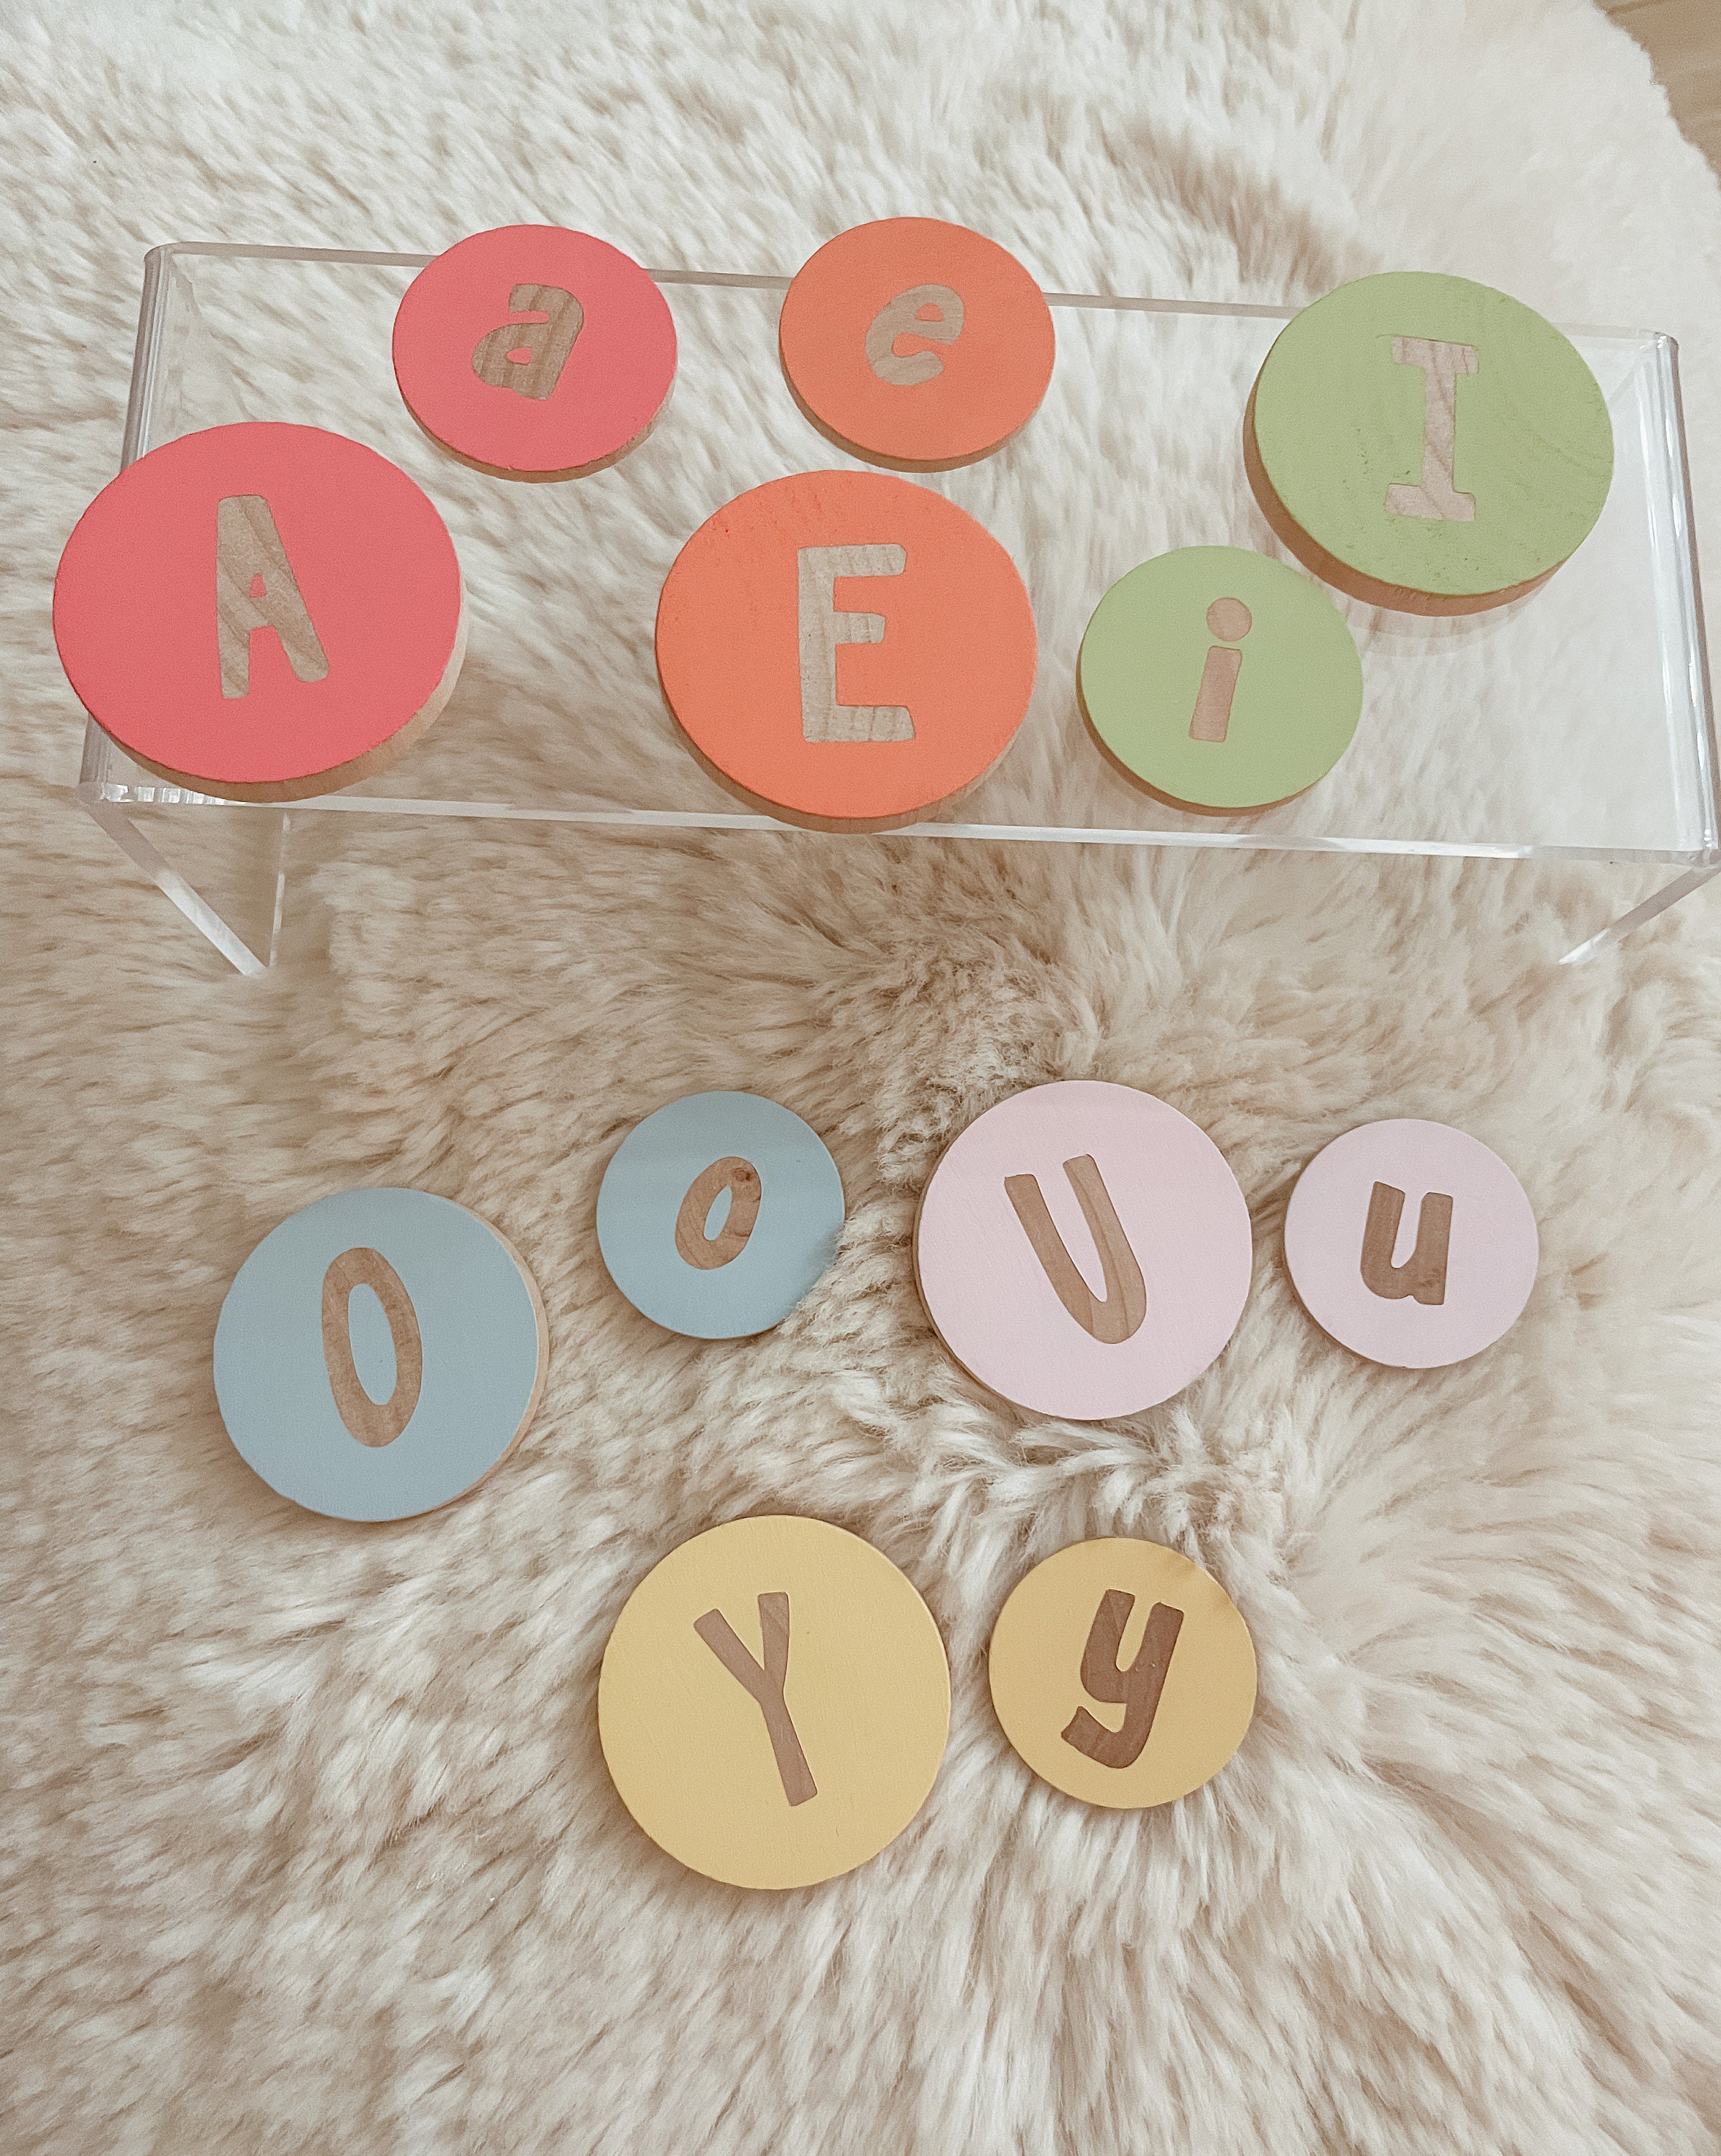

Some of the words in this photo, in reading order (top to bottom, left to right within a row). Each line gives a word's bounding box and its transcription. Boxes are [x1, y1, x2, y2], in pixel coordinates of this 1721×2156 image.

[471, 283, 584, 400] a
[865, 285, 964, 386] e
[1385, 335, 1479, 522] I
[216, 494, 329, 699] A
[798, 544, 915, 743] E
[1189, 597, 1252, 743] i
[675, 1156, 761, 1270] o
[1004, 1153, 1147, 1345] U
[1360, 1180, 1453, 1306] u
[321, 1247, 423, 1447] O
[693, 1593, 818, 1806] Y
[1061, 1589, 1184, 1769] y
